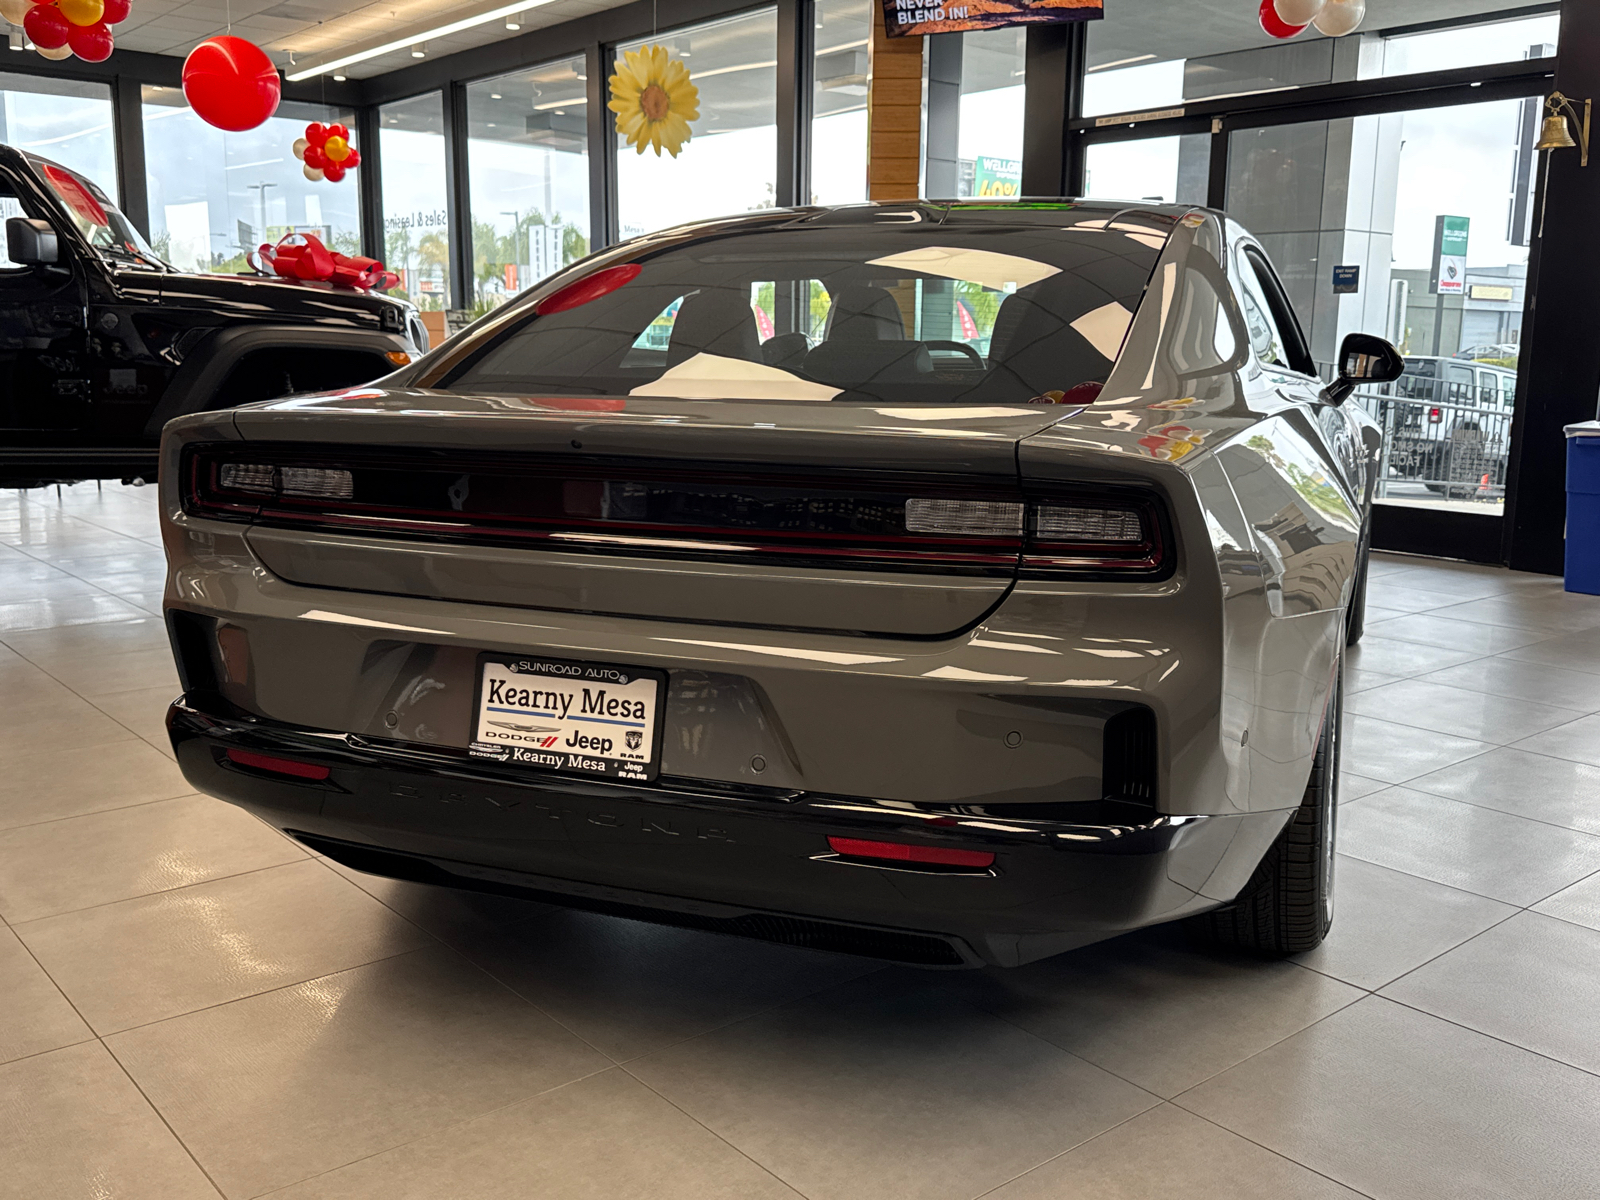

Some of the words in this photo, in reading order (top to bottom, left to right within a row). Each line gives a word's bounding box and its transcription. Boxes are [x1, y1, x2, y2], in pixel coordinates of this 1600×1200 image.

[897, 8, 945, 25] BLEND
[948, 6, 969, 20] IN!
[518, 661, 582, 676] SUNROAD
[585, 668, 620, 680] AUTO
[487, 678, 574, 720] Kearny
[580, 688, 646, 720] Mesa
[485, 731, 546, 744] DODGE
[565, 730, 613, 755] Jeep
[513, 747, 565, 770] Kearny
[568, 754, 606, 771] Mesa
[620, 752, 645, 760] RAM
[618, 770, 648, 780] RAM
[624, 761, 644, 772] Jeep
[388, 783, 738, 844] DAYTONA
